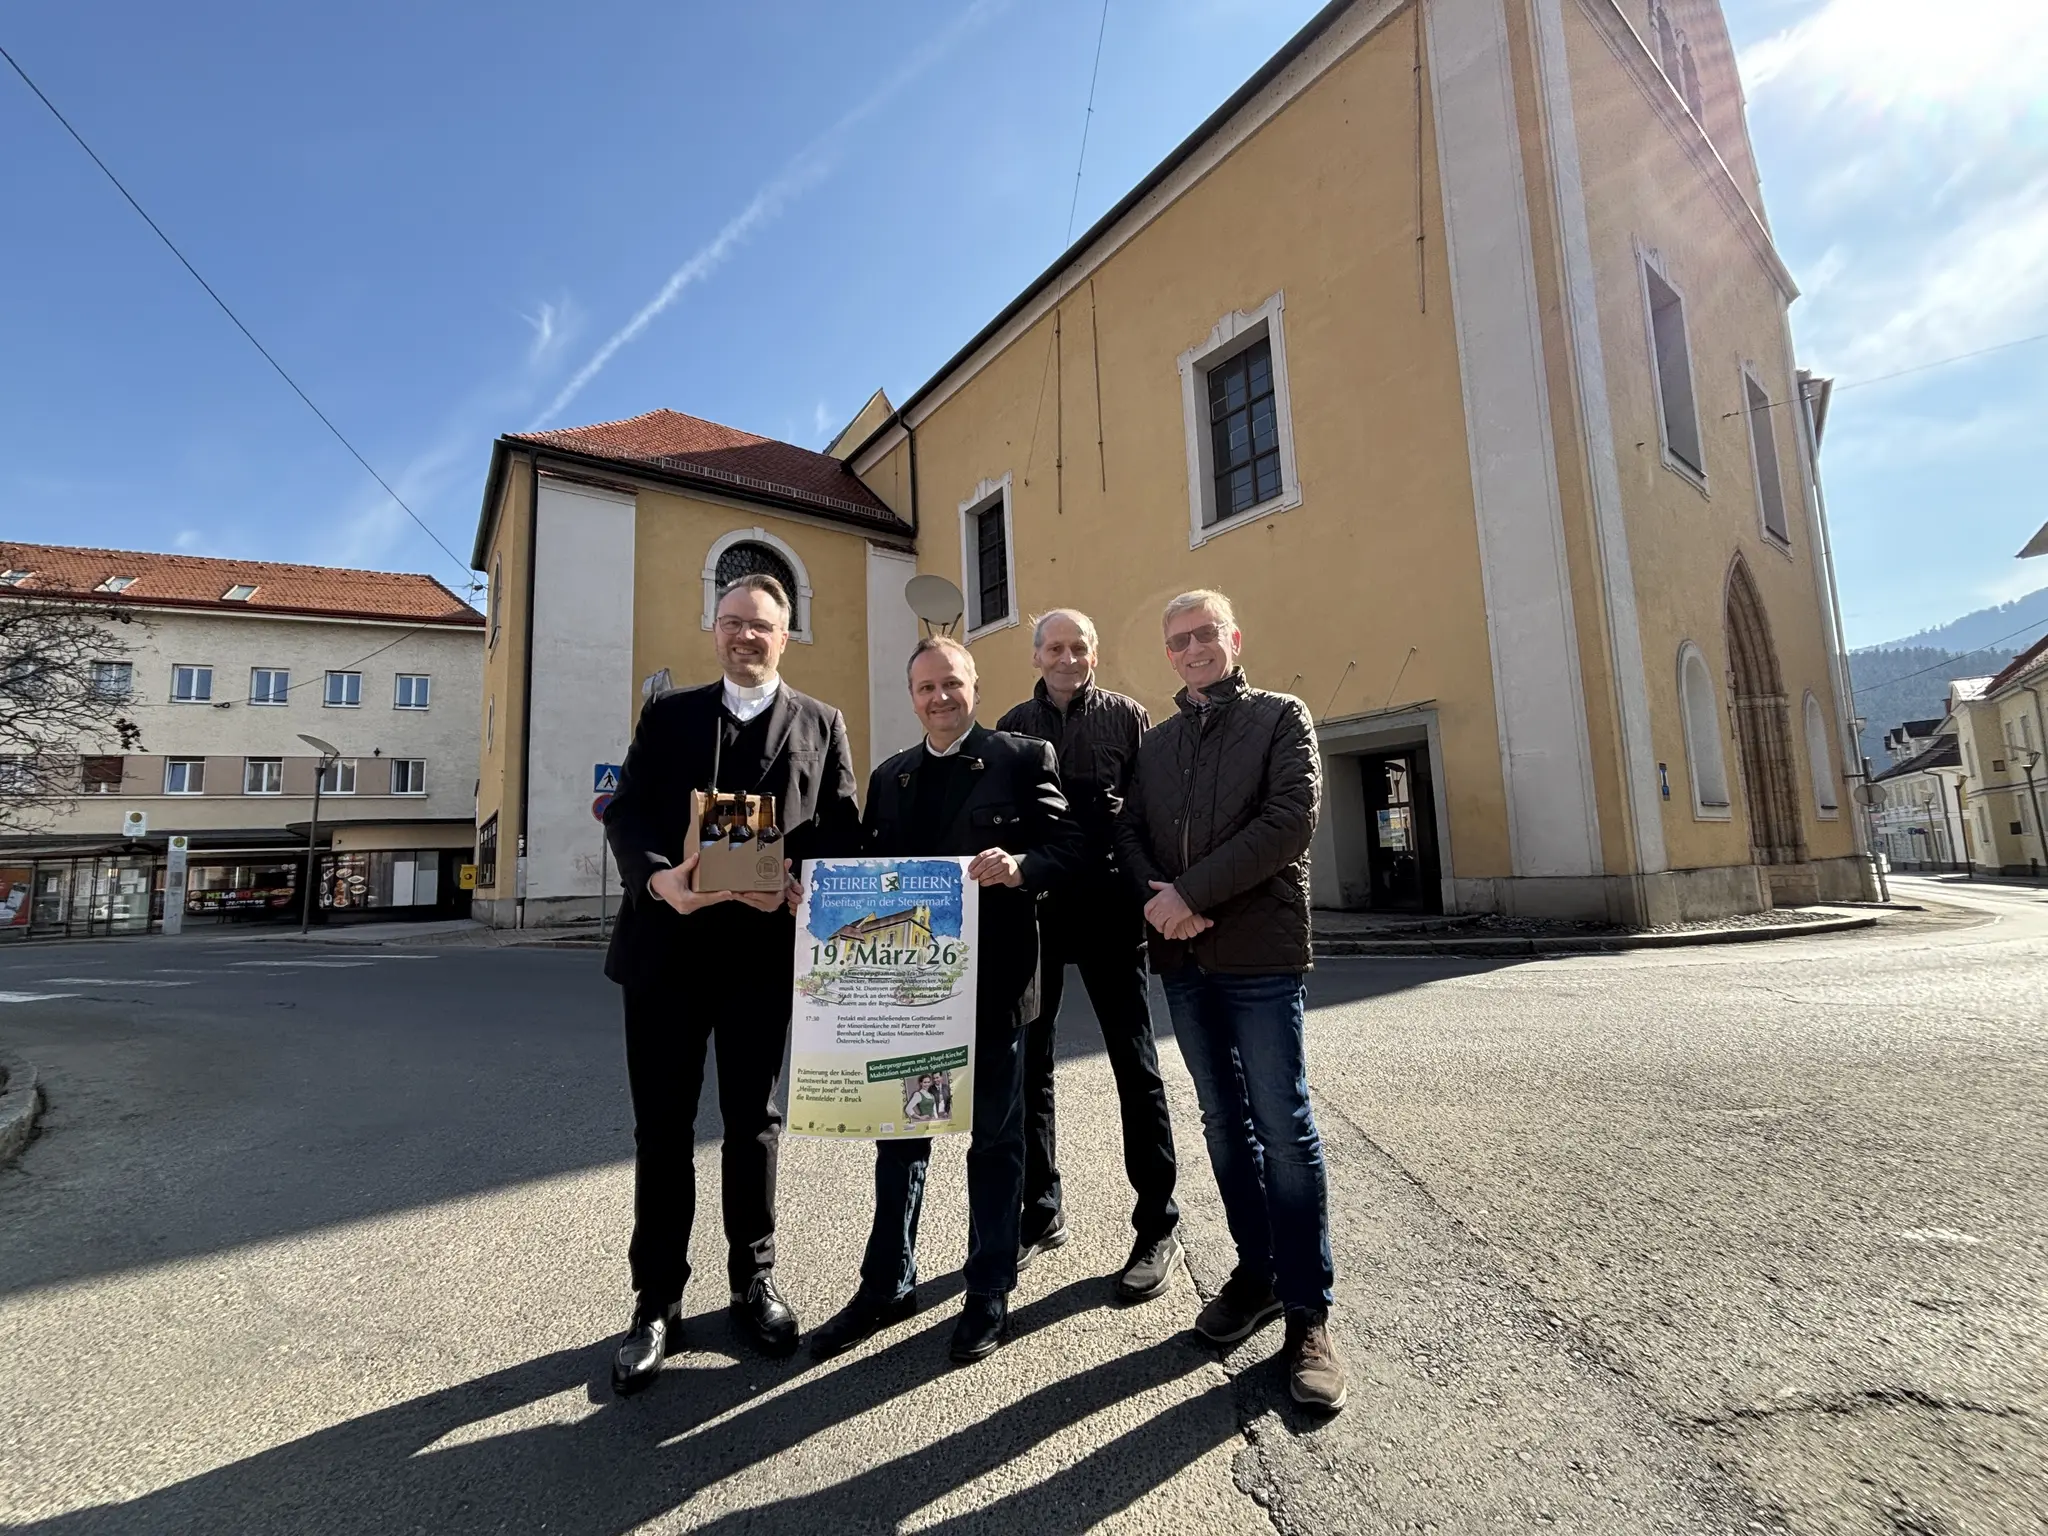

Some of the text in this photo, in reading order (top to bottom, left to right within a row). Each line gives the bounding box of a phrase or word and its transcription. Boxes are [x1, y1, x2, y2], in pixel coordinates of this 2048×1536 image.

[822, 876, 952, 890] STEIRER FEIERN
[821, 895, 951, 909] Josefitag in der Steiermark
[811, 943, 957, 965] 19. März 26
[869, 1060, 915, 1071] Kinderprogramm
[869, 1069, 899, 1078] Malstation
[912, 1064, 929, 1073] vielen
[930, 1058, 966, 1070] Spielstationen
[797, 1068, 828, 1077] Prämierung
[841, 1086, 858, 1094] durch
[796, 1093, 804, 1101] die
[806, 1094, 835, 1102] Rennfelder
[844, 1095, 862, 1103] Bruck
